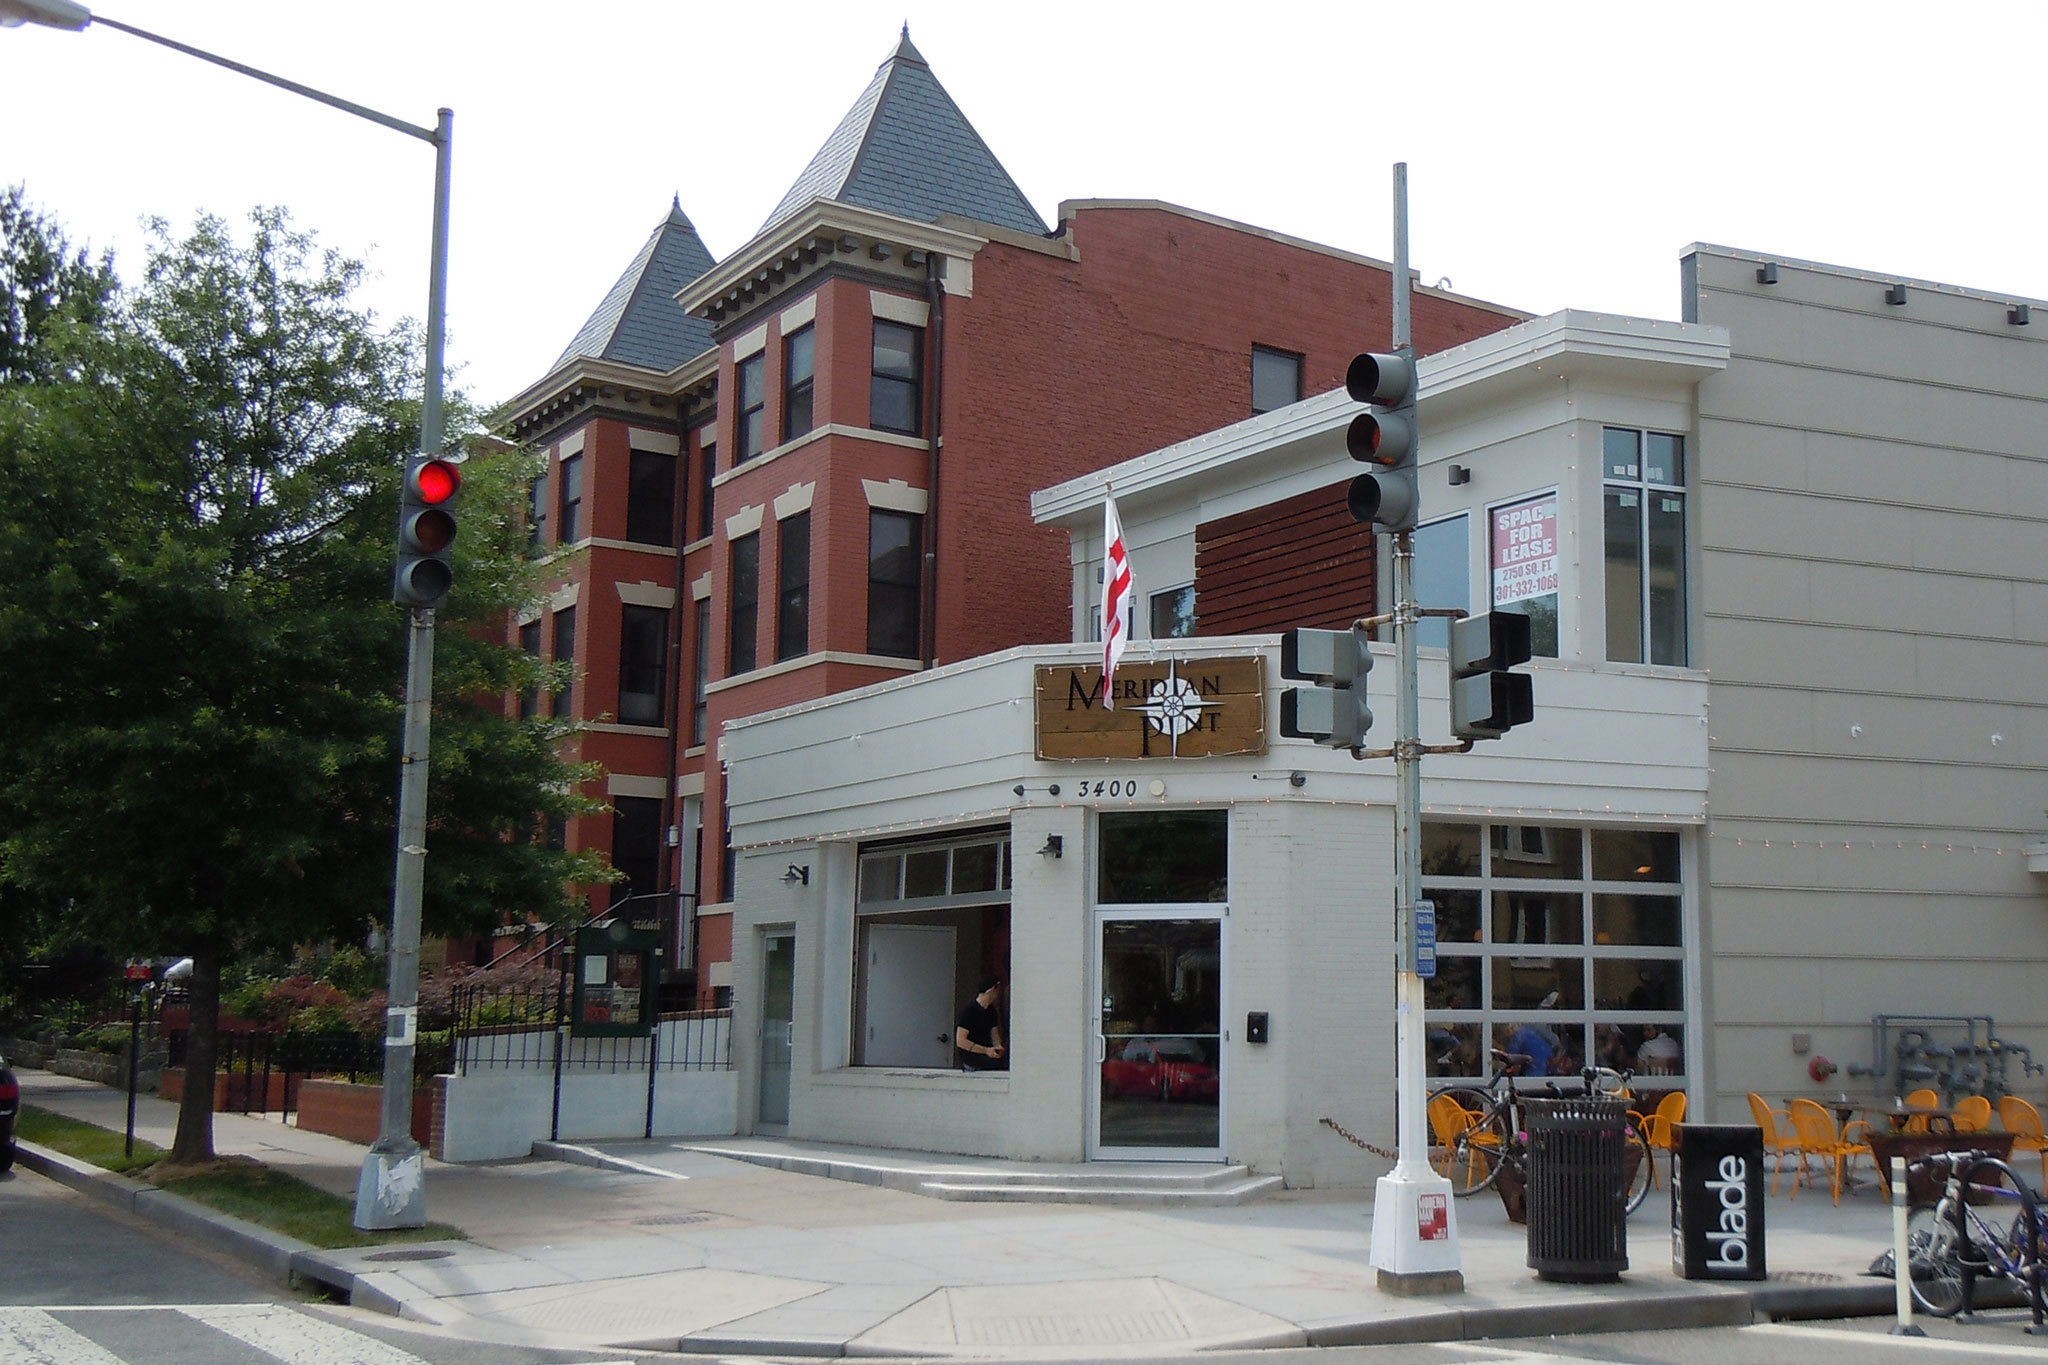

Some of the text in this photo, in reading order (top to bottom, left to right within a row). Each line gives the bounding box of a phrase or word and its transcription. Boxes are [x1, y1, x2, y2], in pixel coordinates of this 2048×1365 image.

[1510, 523, 1543, 545] FOR
[1502, 538, 1553, 564] LEASE
[1502, 567, 1524, 582] 2750
[1525, 562, 1540, 576] SQ.
[1078, 780, 1137, 798] 3400
[1704, 1154, 1748, 1269] blade
